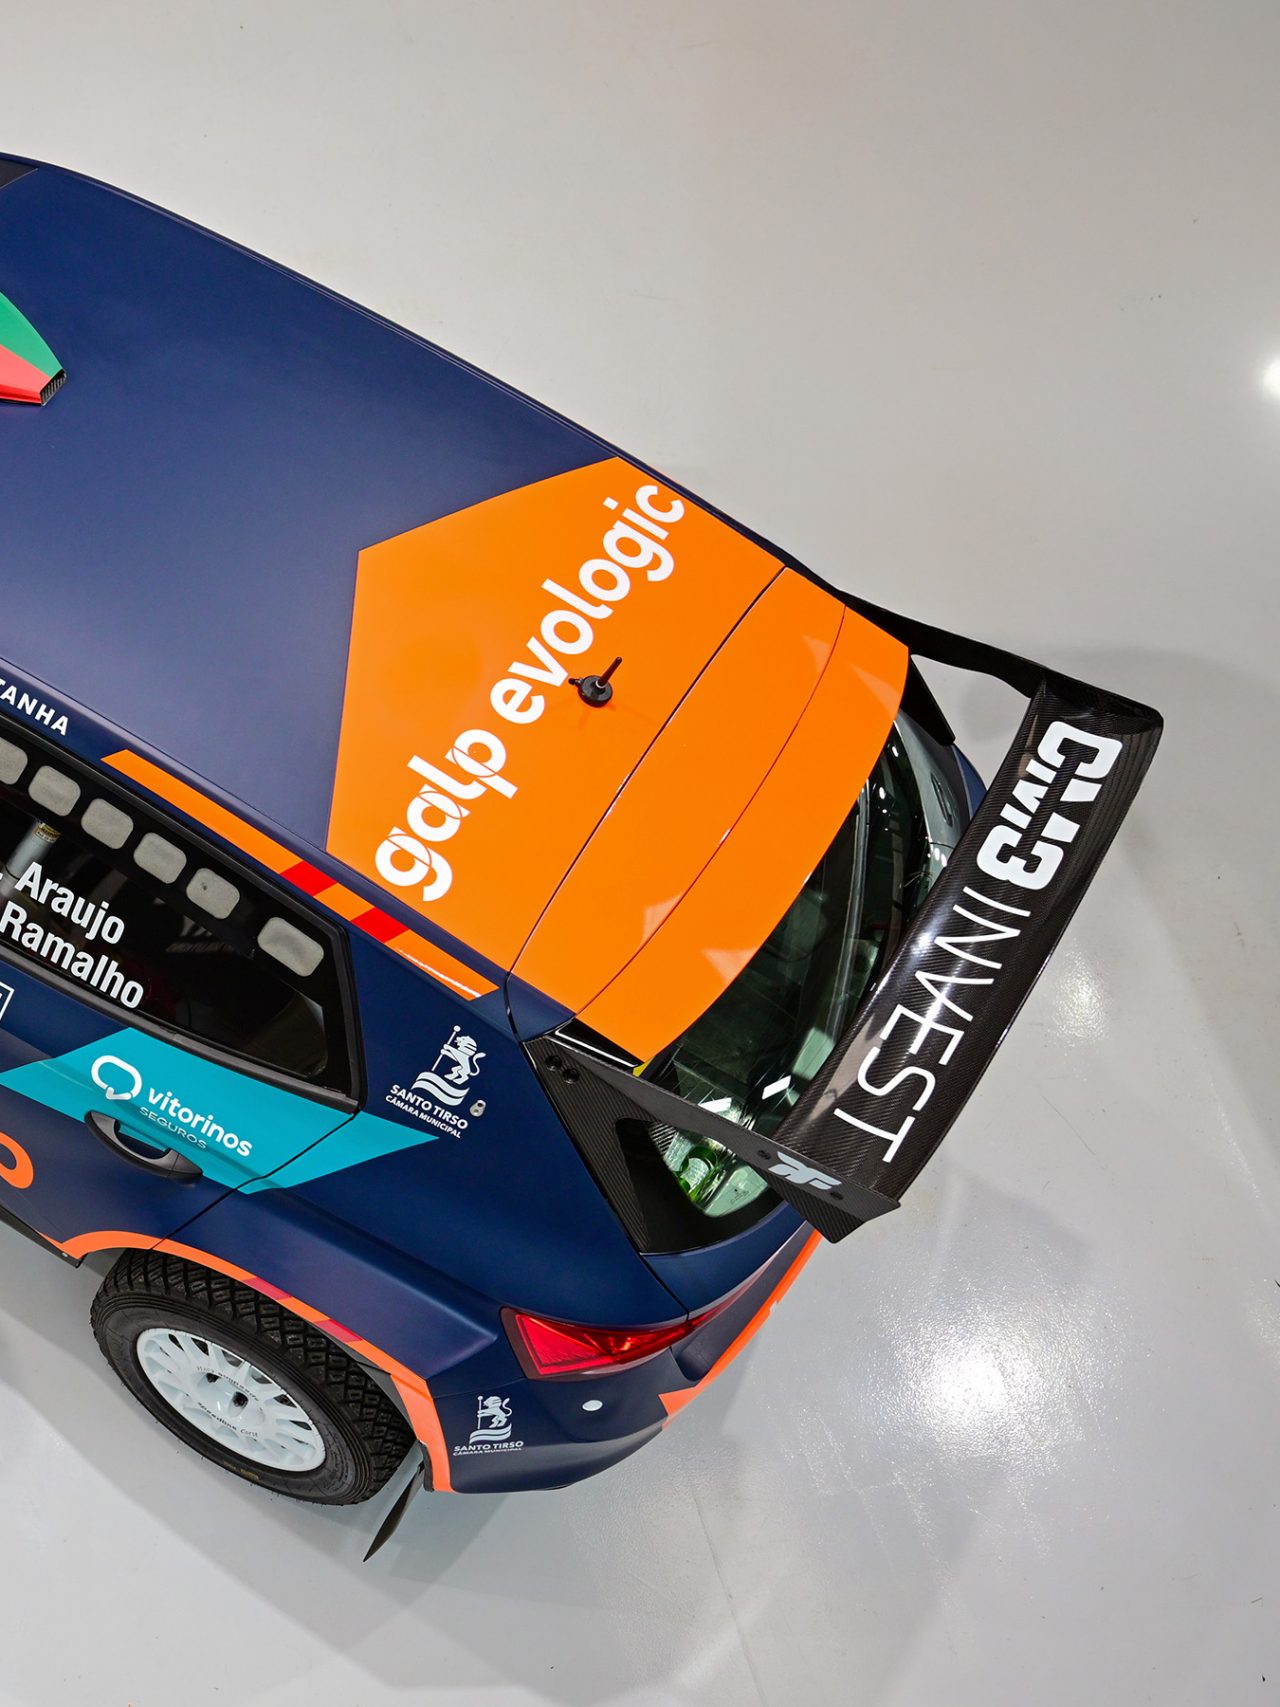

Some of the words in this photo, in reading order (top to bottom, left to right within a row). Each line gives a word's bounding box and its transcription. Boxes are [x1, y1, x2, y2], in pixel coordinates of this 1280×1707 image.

[374, 728, 519, 902] galp
[489, 483, 686, 725] evologic
[14, 861, 126, 945] Araujo
[833, 885, 1031, 1163] INVEST
[139, 1106, 207, 1150] SEGUROS
[147, 1086, 253, 1158] vitorinos
[390, 1084, 432, 1111] SANTO
[432, 1105, 468, 1130] TIRSO
[418, 1112, 461, 1139] MUNICIPAL
[454, 1443, 491, 1452] SANTO
[492, 1440, 524, 1449] TIRSO
